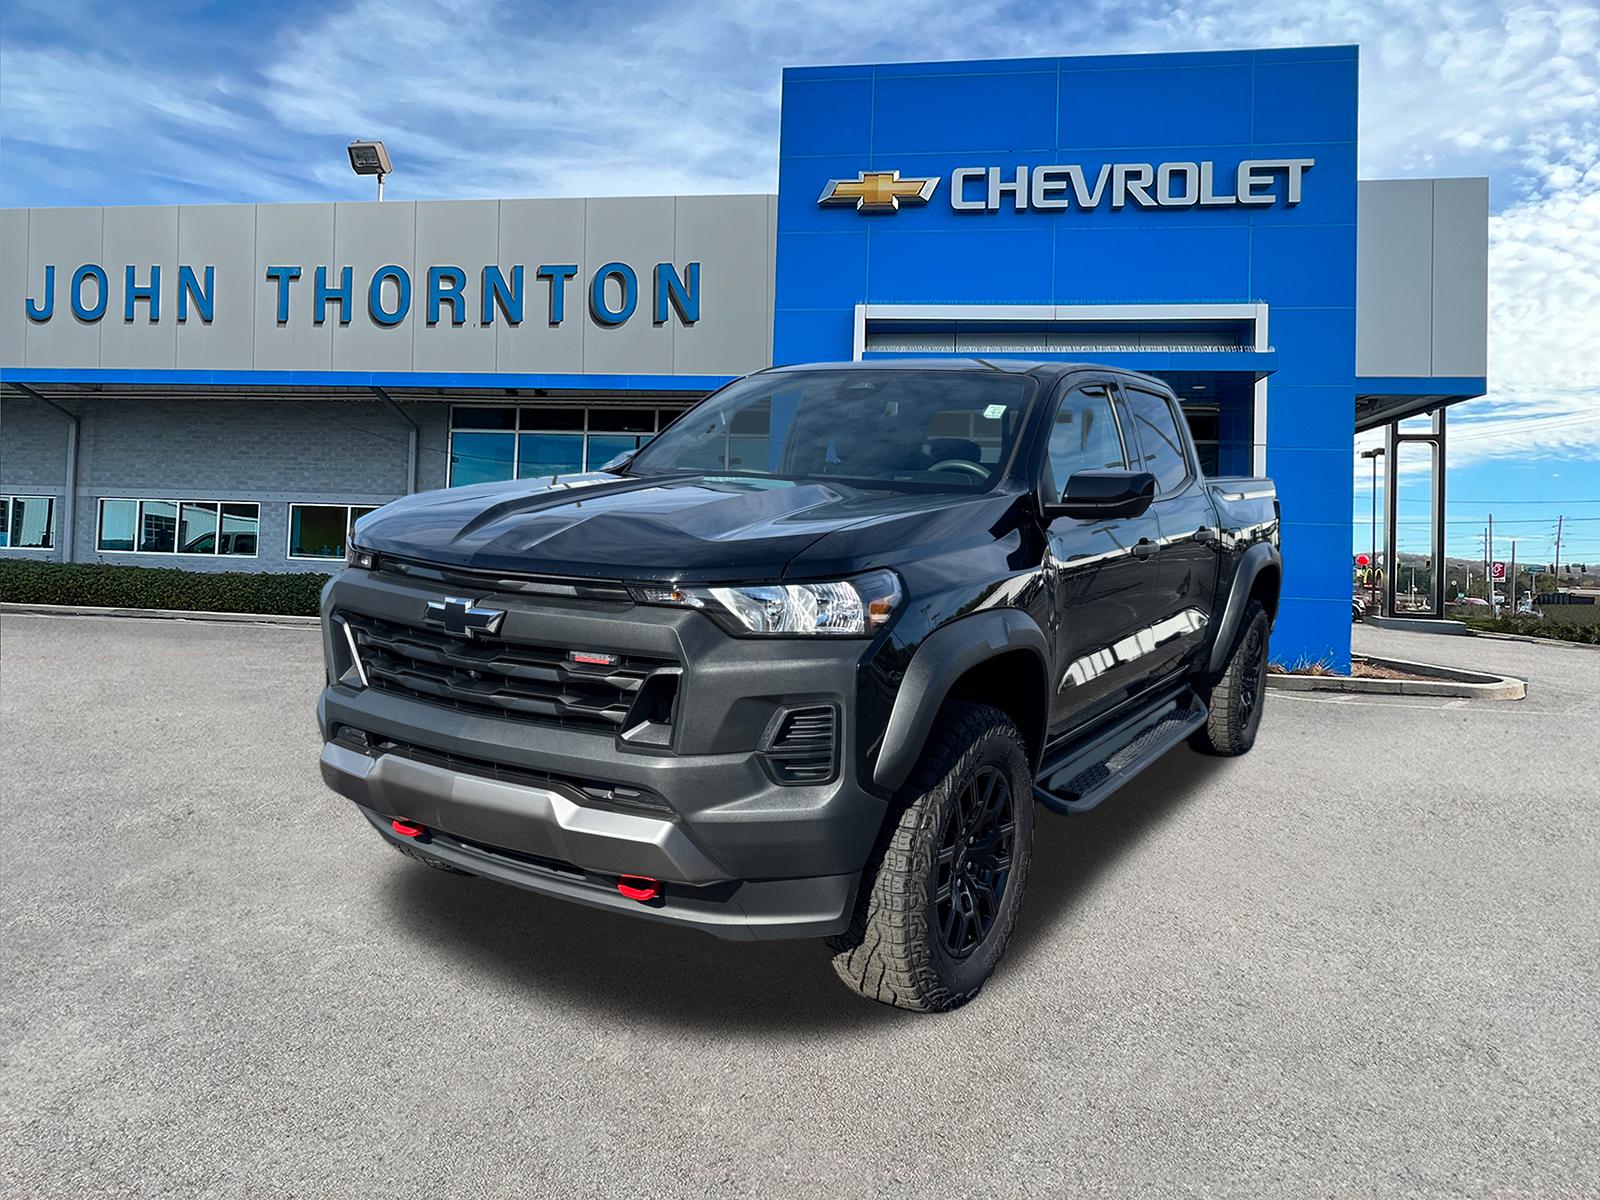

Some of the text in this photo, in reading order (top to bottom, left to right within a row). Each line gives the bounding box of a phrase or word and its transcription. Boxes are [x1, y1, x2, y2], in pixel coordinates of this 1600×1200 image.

[951, 159, 1315, 210] CHEVROLET
[26, 262, 700, 326] JOHN THORNTON
